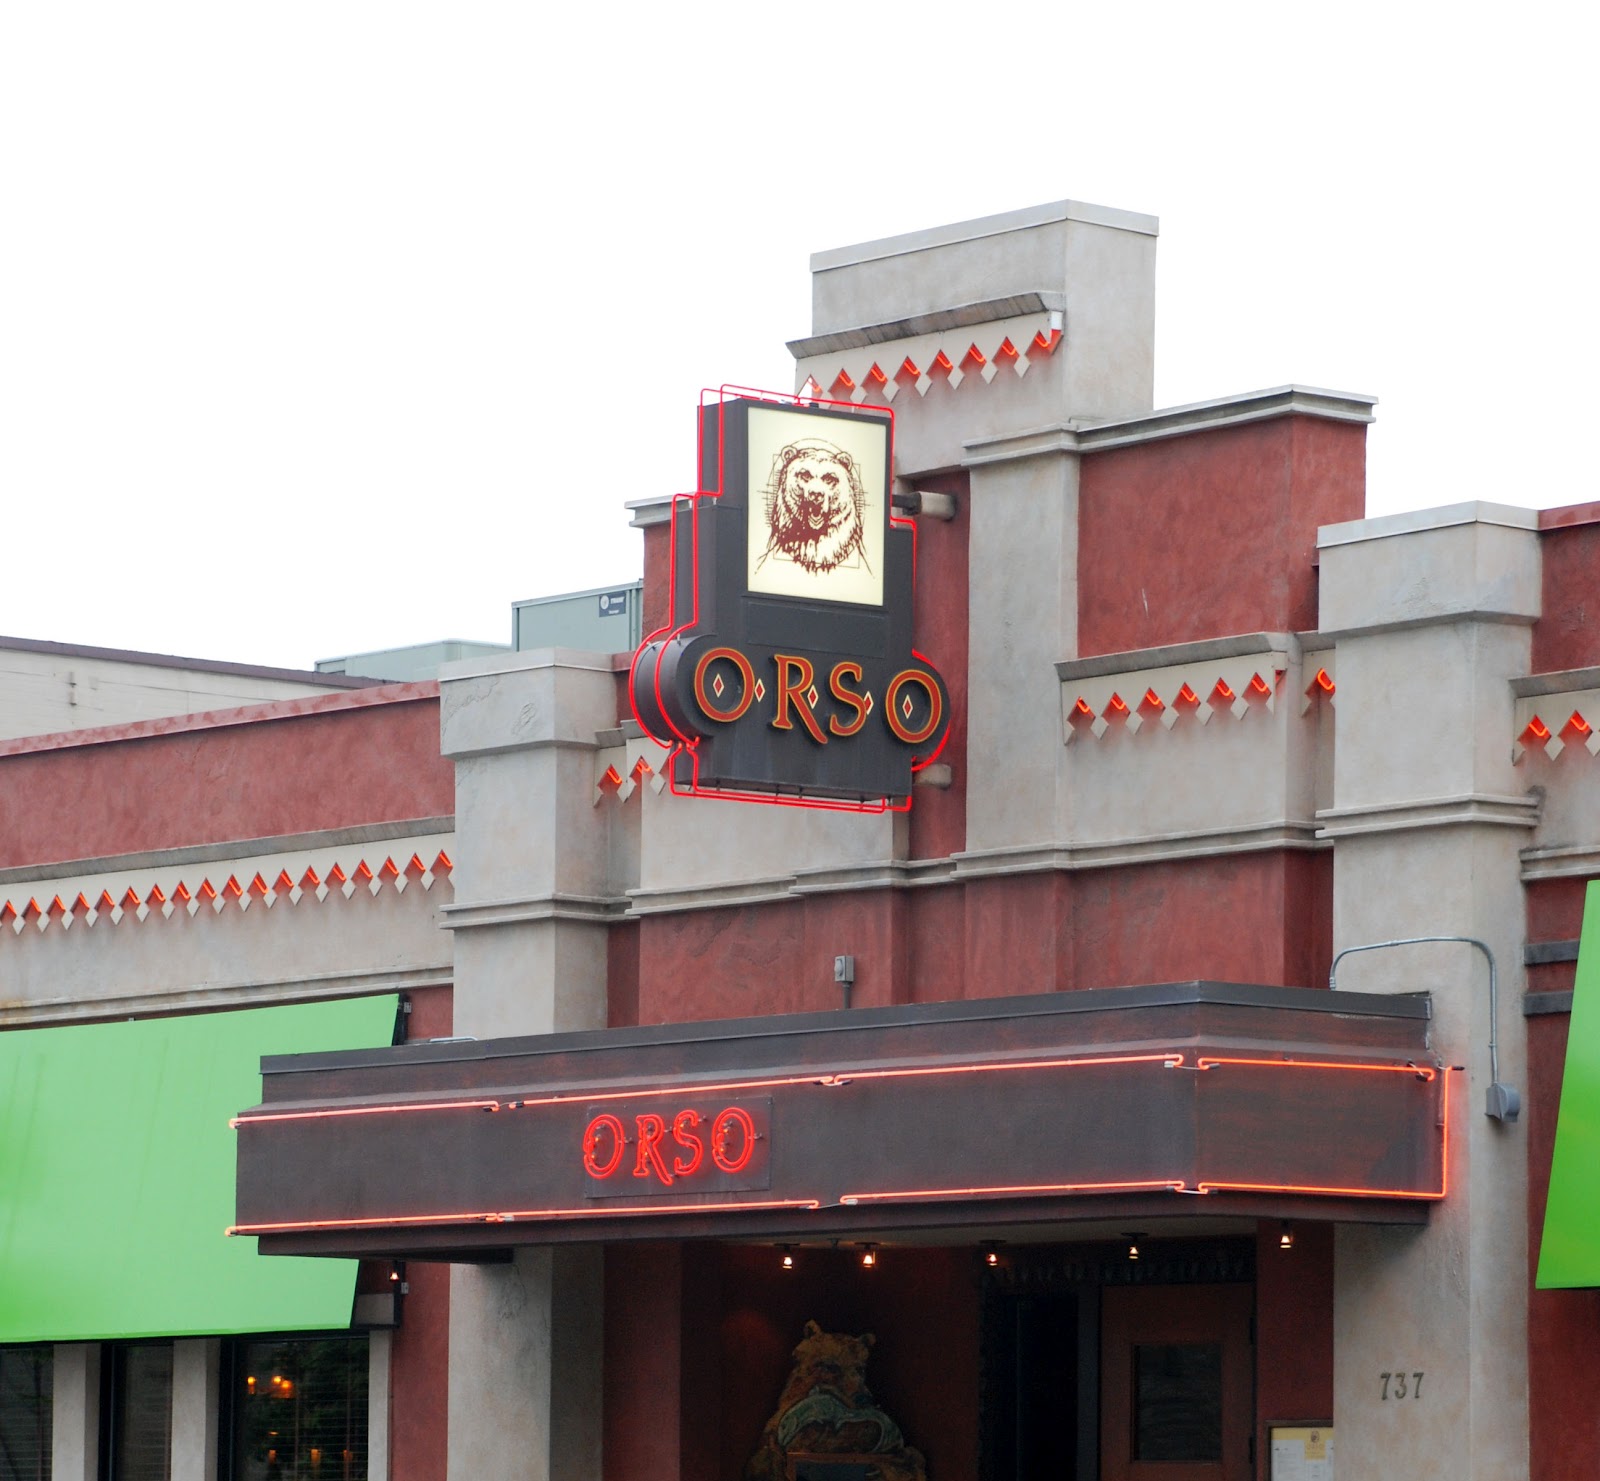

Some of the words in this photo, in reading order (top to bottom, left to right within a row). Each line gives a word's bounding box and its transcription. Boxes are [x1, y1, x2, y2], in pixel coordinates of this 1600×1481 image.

[694, 647, 942, 744] ORSO
[583, 1107, 754, 1186] ORSO
[1380, 1372, 1424, 1400] 737
